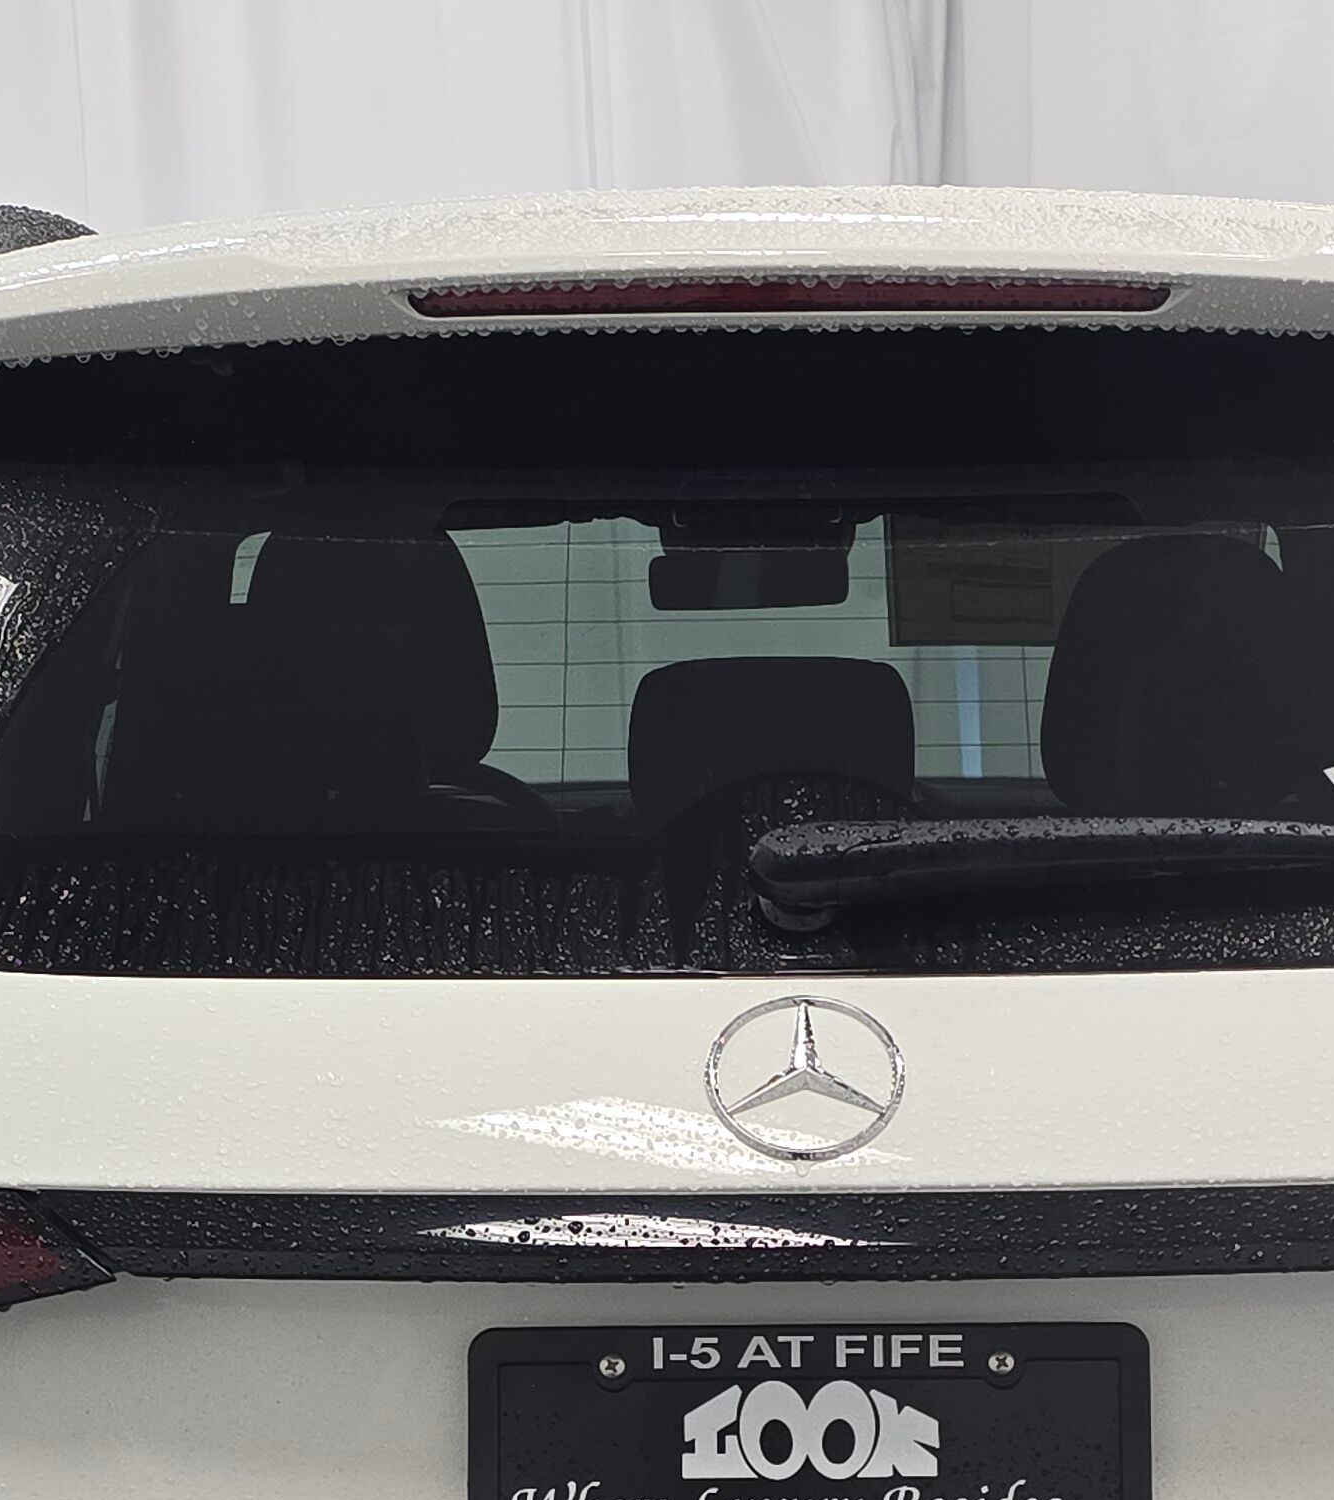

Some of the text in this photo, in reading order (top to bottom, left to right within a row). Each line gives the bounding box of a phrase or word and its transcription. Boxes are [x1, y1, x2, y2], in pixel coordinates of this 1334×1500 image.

[652, 1333, 965, 1370] I-5 AT FIFE
[681, 1379, 940, 1481] LOOK
